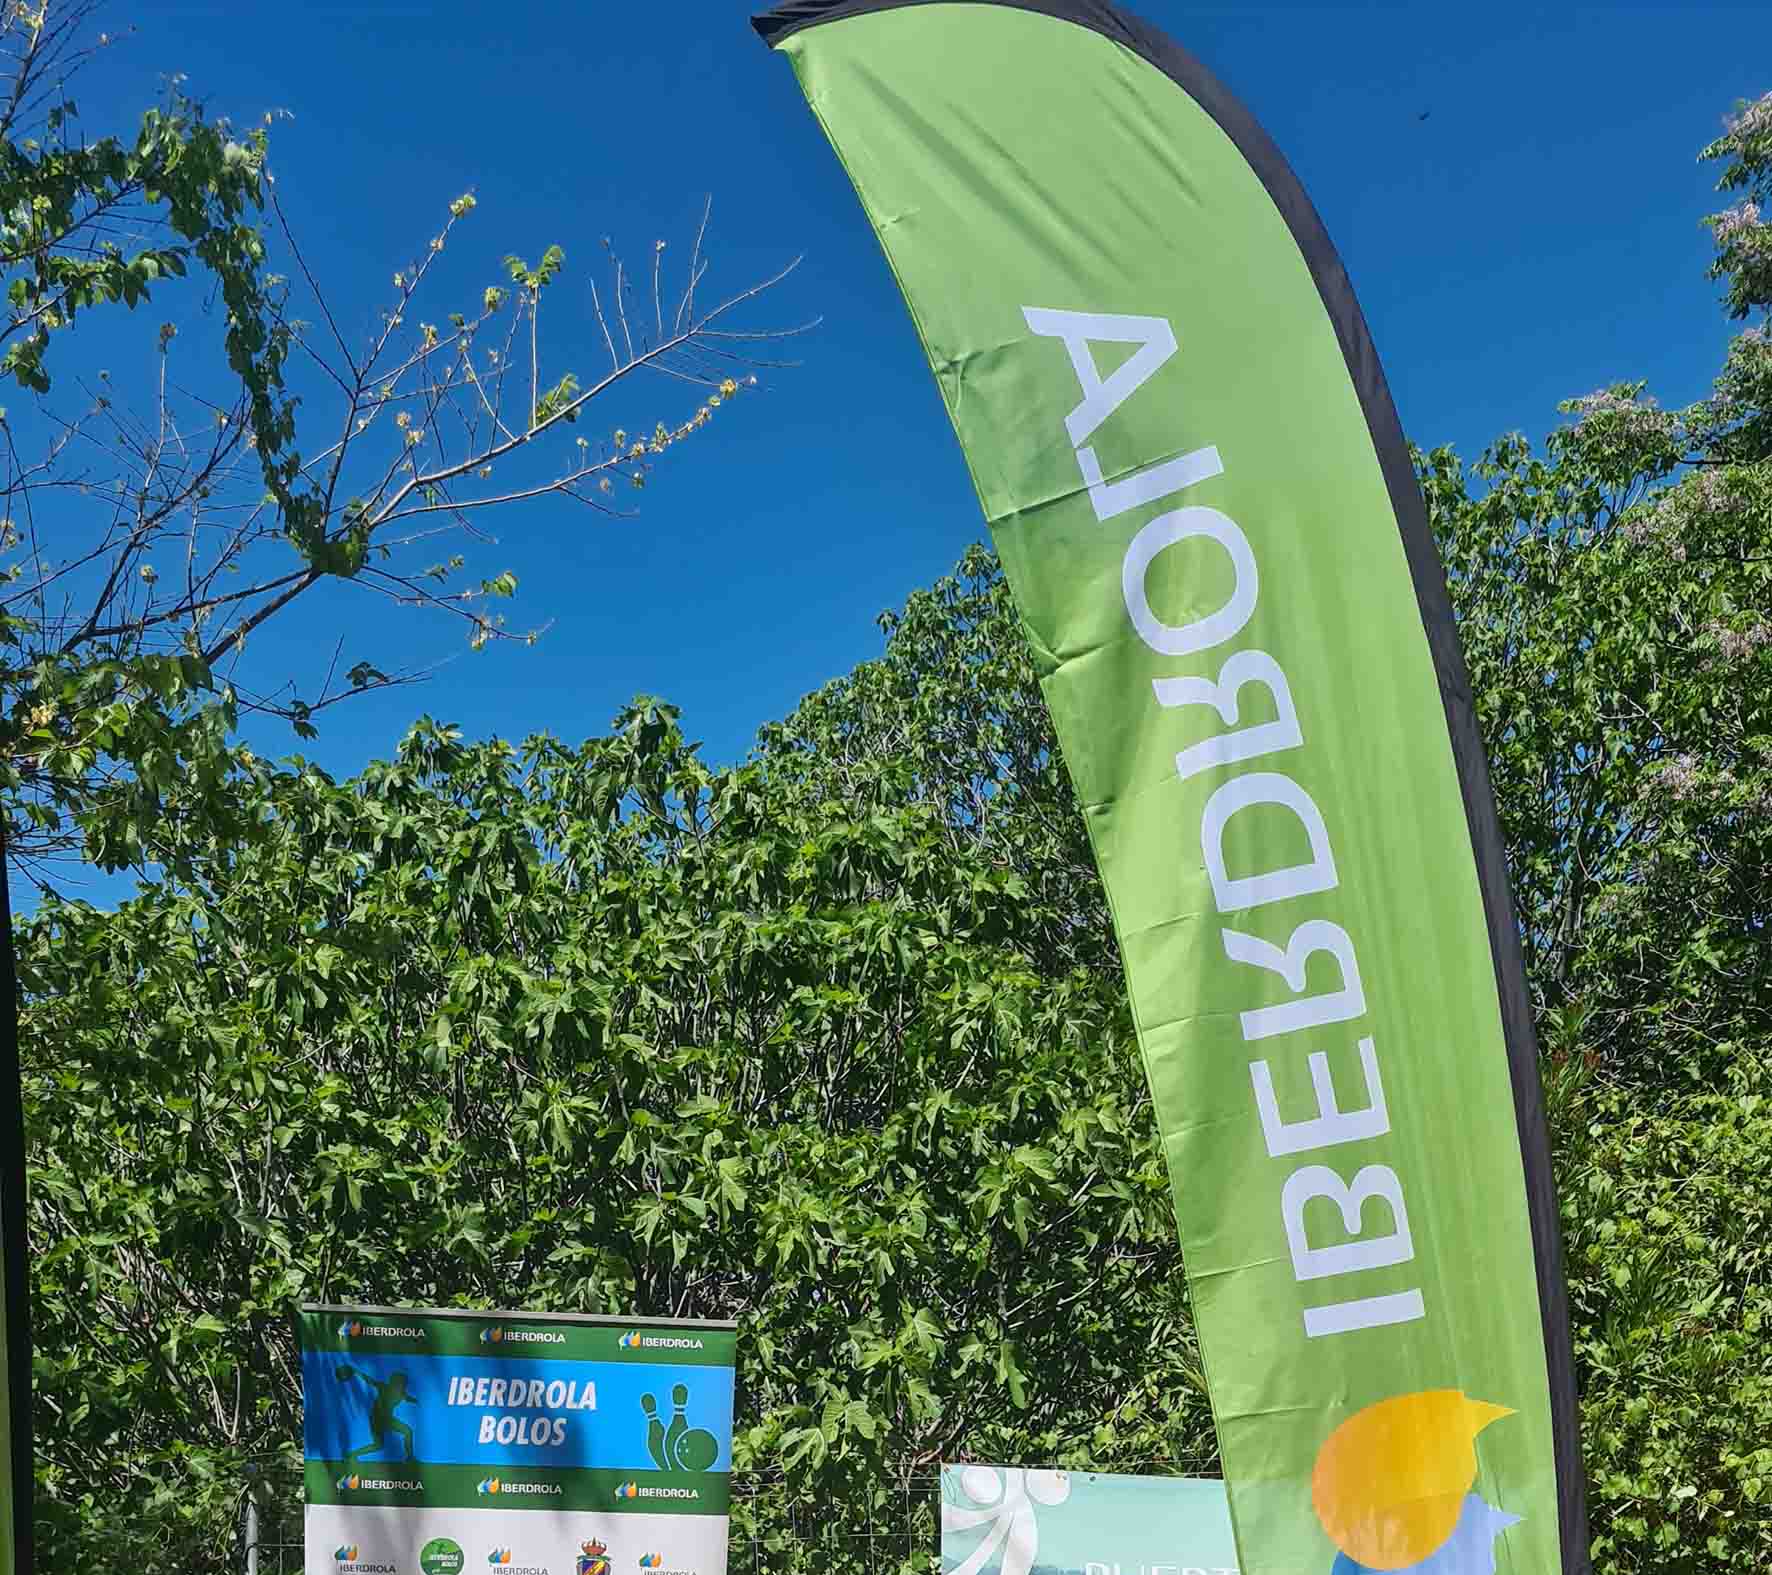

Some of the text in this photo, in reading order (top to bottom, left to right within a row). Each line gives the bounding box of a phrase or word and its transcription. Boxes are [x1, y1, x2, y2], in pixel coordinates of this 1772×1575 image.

[361, 1325, 426, 1338] IBERDROLA
[503, 1330, 567, 1344] IBERDROLA
[641, 1335, 704, 1350] IBERDROLA
[447, 1376, 598, 1411] IBERDROLA
[478, 1415, 568, 1446] BOLOS
[360, 1478, 425, 1491] IBERDROLA
[500, 1481, 563, 1495] IBERDROLA
[637, 1485, 699, 1500] IBERDROLA
